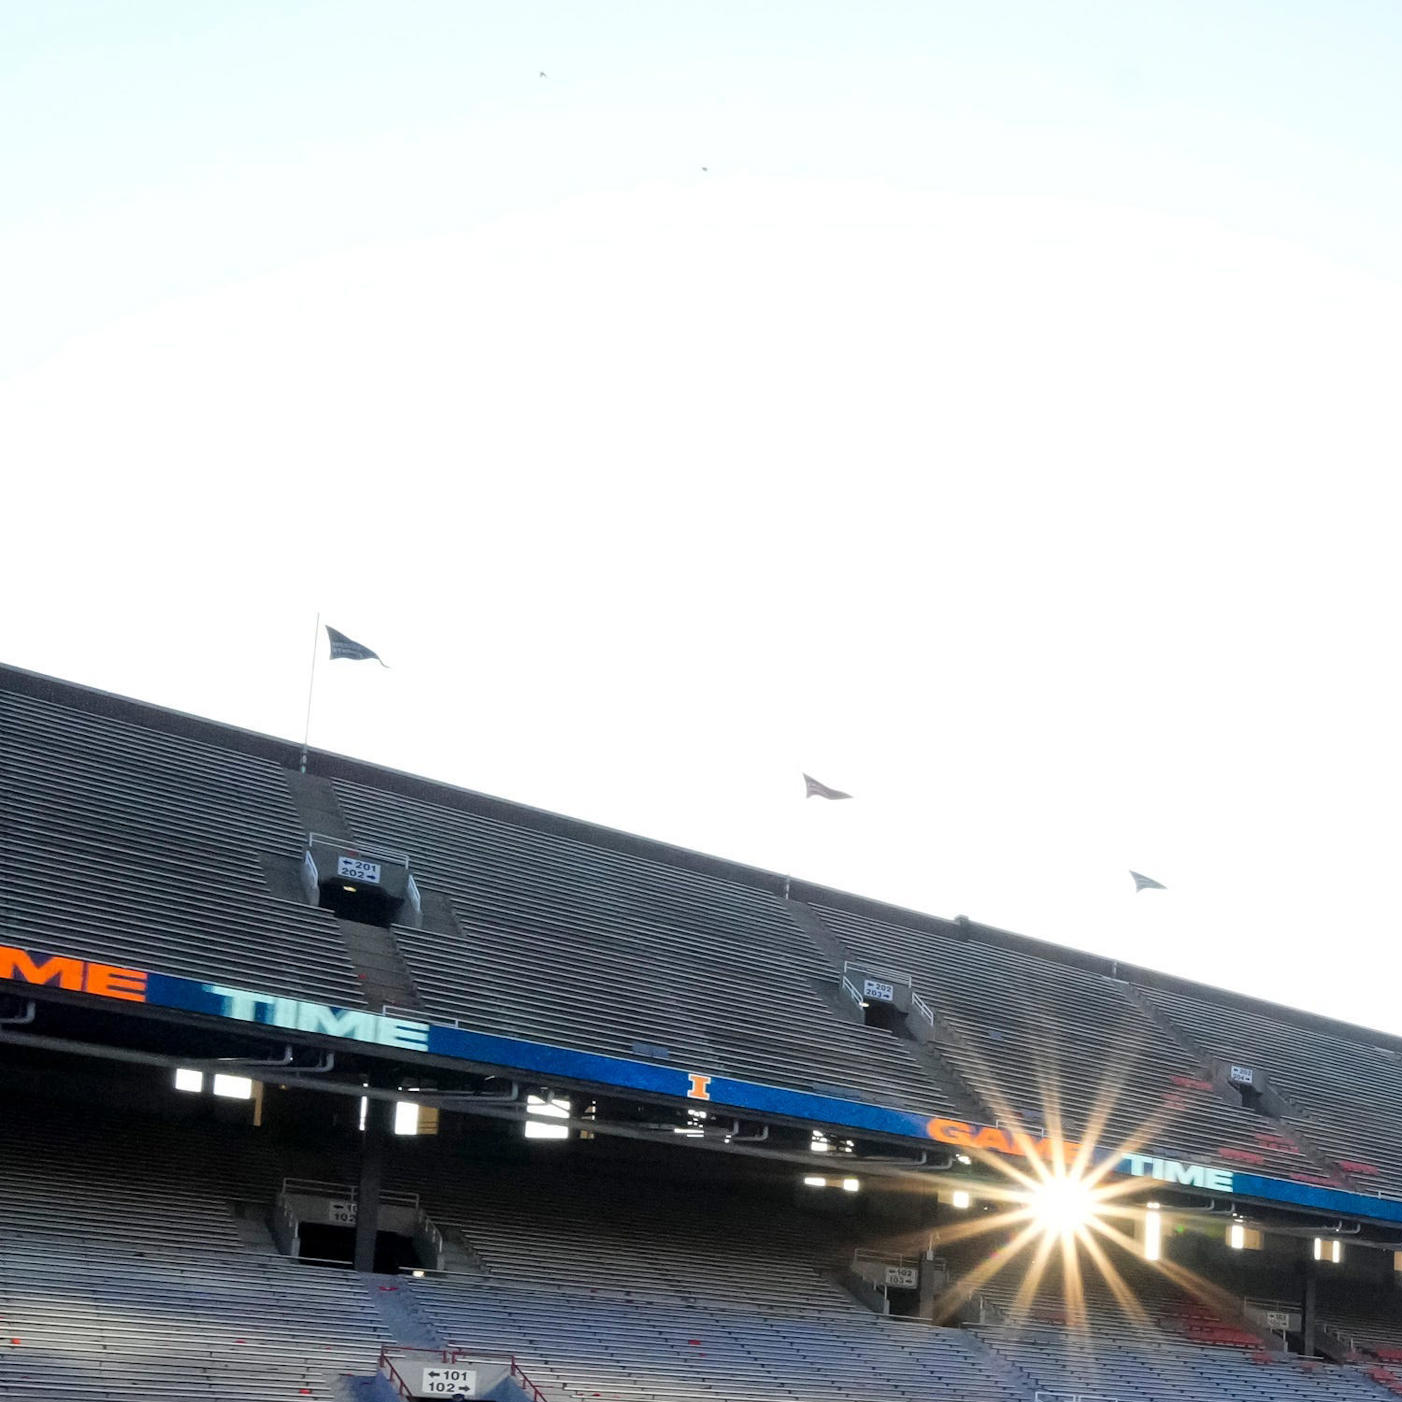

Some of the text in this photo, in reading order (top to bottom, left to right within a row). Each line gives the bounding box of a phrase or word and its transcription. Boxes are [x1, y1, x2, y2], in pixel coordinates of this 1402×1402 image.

[355, 861, 376, 872] 201
[341, 867, 365, 879] 202
[203, 984, 430, 1053] TIME
[687, 1073, 711, 1100] I
[1120, 1152, 1234, 1193] TIME
[443, 1370, 467, 1381] 101
[428, 1382, 456, 1393] 102
